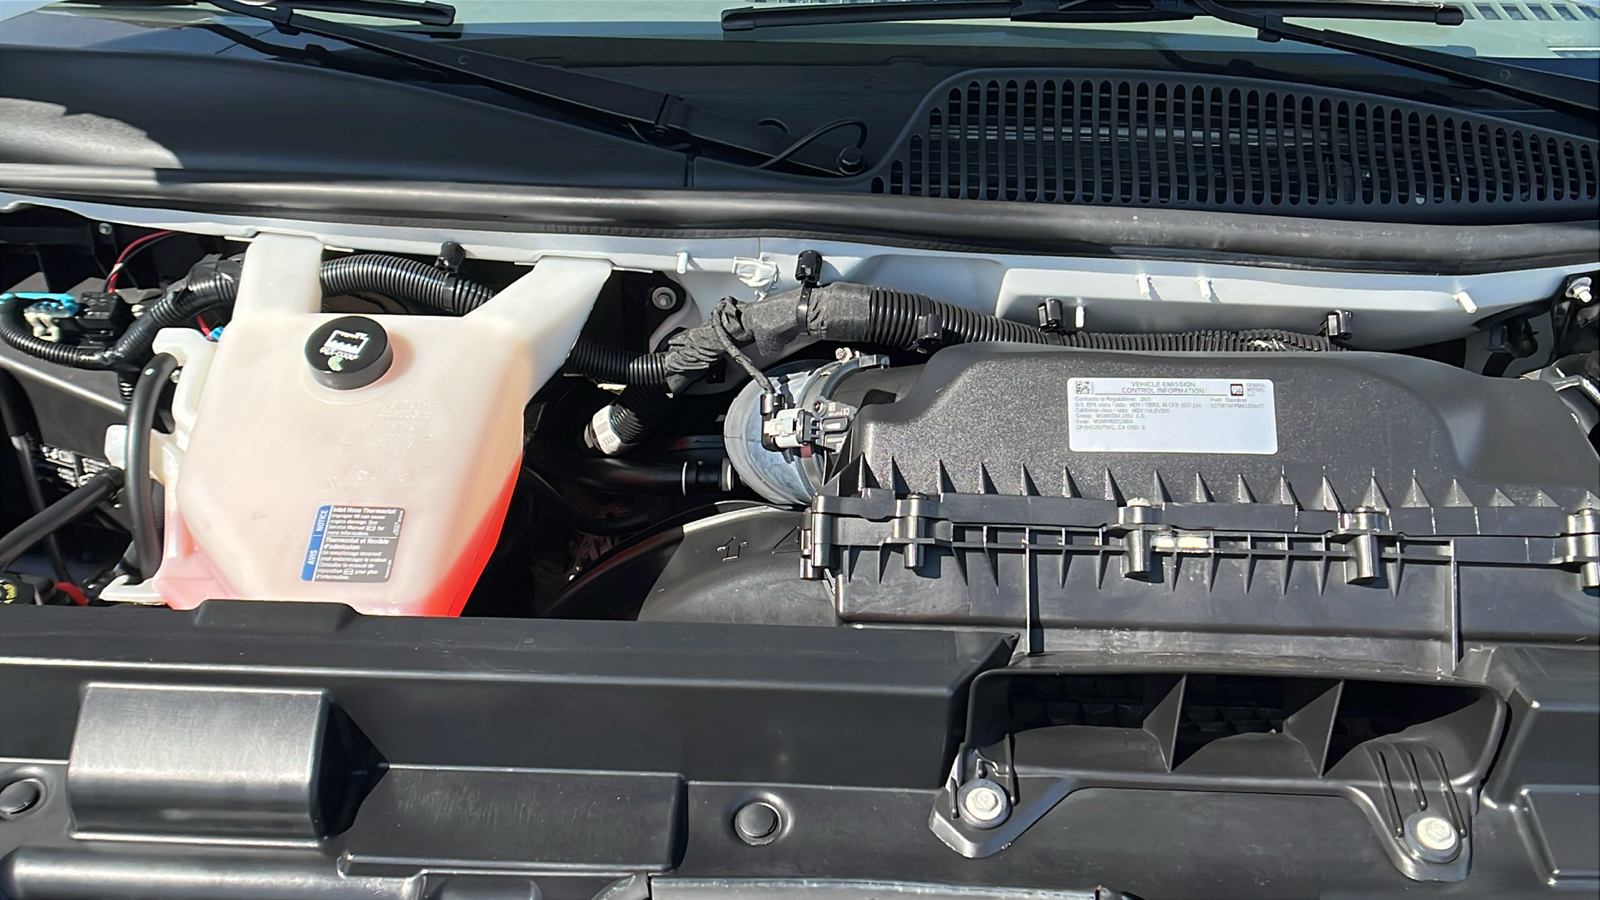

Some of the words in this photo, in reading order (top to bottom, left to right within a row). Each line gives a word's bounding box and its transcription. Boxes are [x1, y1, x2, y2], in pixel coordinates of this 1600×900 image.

[404, 400, 442, 409] TETHER
[307, 550, 318, 565] AVIS
[315, 510, 328, 531] NOTICE
